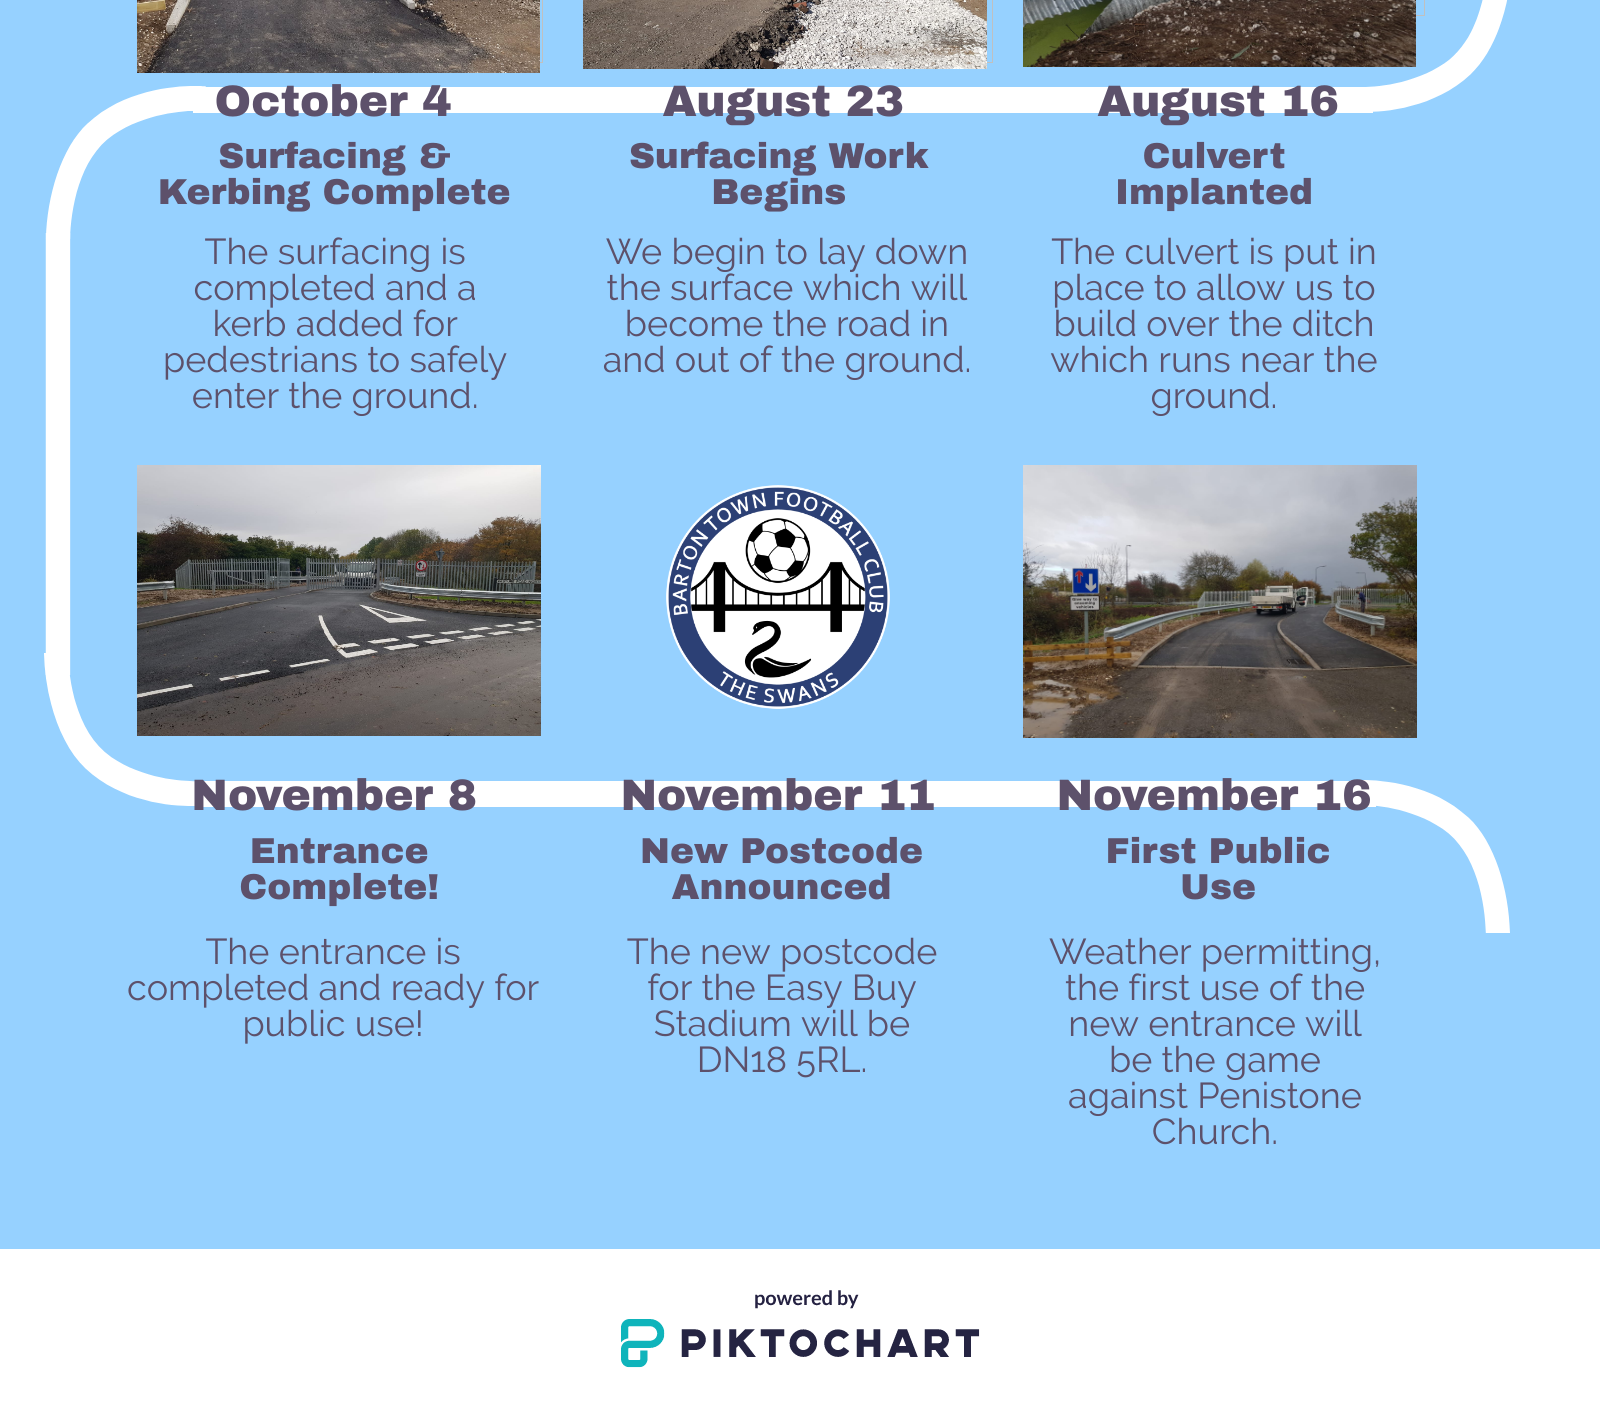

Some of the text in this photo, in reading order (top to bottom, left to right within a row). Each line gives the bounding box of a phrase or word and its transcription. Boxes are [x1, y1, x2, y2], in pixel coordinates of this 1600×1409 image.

[215, 83, 452, 118] October 4
[662, 84, 903, 126] August 23
[1097, 84, 1338, 126] August 16
[219, 140, 451, 177] Surfacing &
[629, 140, 930, 177] Surfacing Work
[1143, 141, 1286, 170] Culvert
[159, 177, 510, 213] Kerbing Complete
[713, 177, 846, 213] Begins
[1117, 177, 1312, 212] Implanted
[204, 236, 466, 273] The surfacing is
[605, 237, 967, 273] We begin to lay down
[1051, 237, 1375, 273] The culvert is put in
[194, 273, 476, 309] completed and a
[1055, 309, 1373, 338] build over the ditch
[165, 344, 507, 381] pedestrians to safely
[603, 344, 970, 381] and out of the ground.
[1151, 381, 1276, 417] ground.
[672, 491, 885, 616] BARTON TOWN FOOTBALL CLUB
[718, 670, 840, 704] THE SWANS
[193, 777, 476, 812] November 8
[623, 777, 935, 812] November 11
[1059, 777, 1371, 812] November 16
[251, 837, 428, 865] Entrance
[641, 836, 923, 865] New Postcode
[1107, 836, 1330, 865] First Public
[240, 872, 439, 907] Complete!
[671, 872, 891, 901] Announced
[1181, 873, 1256, 901] Use
[205, 937, 461, 966] The entrance is
[626, 937, 937, 973] The new postcode
[1049, 937, 1379, 973] Weather permitting,
[647, 972, 917, 1009] for the Easy Buy
[244, 1009, 422, 1045] public use!
[1070, 1009, 1363, 1038] new entrance will
[699, 1045, 866, 1079] DN18 5RL.
[1152, 1117, 1277, 1146] Church.
[754, 1289, 859, 1310] powered by
[680, 1328, 980, 1358] PIKTOCHART
